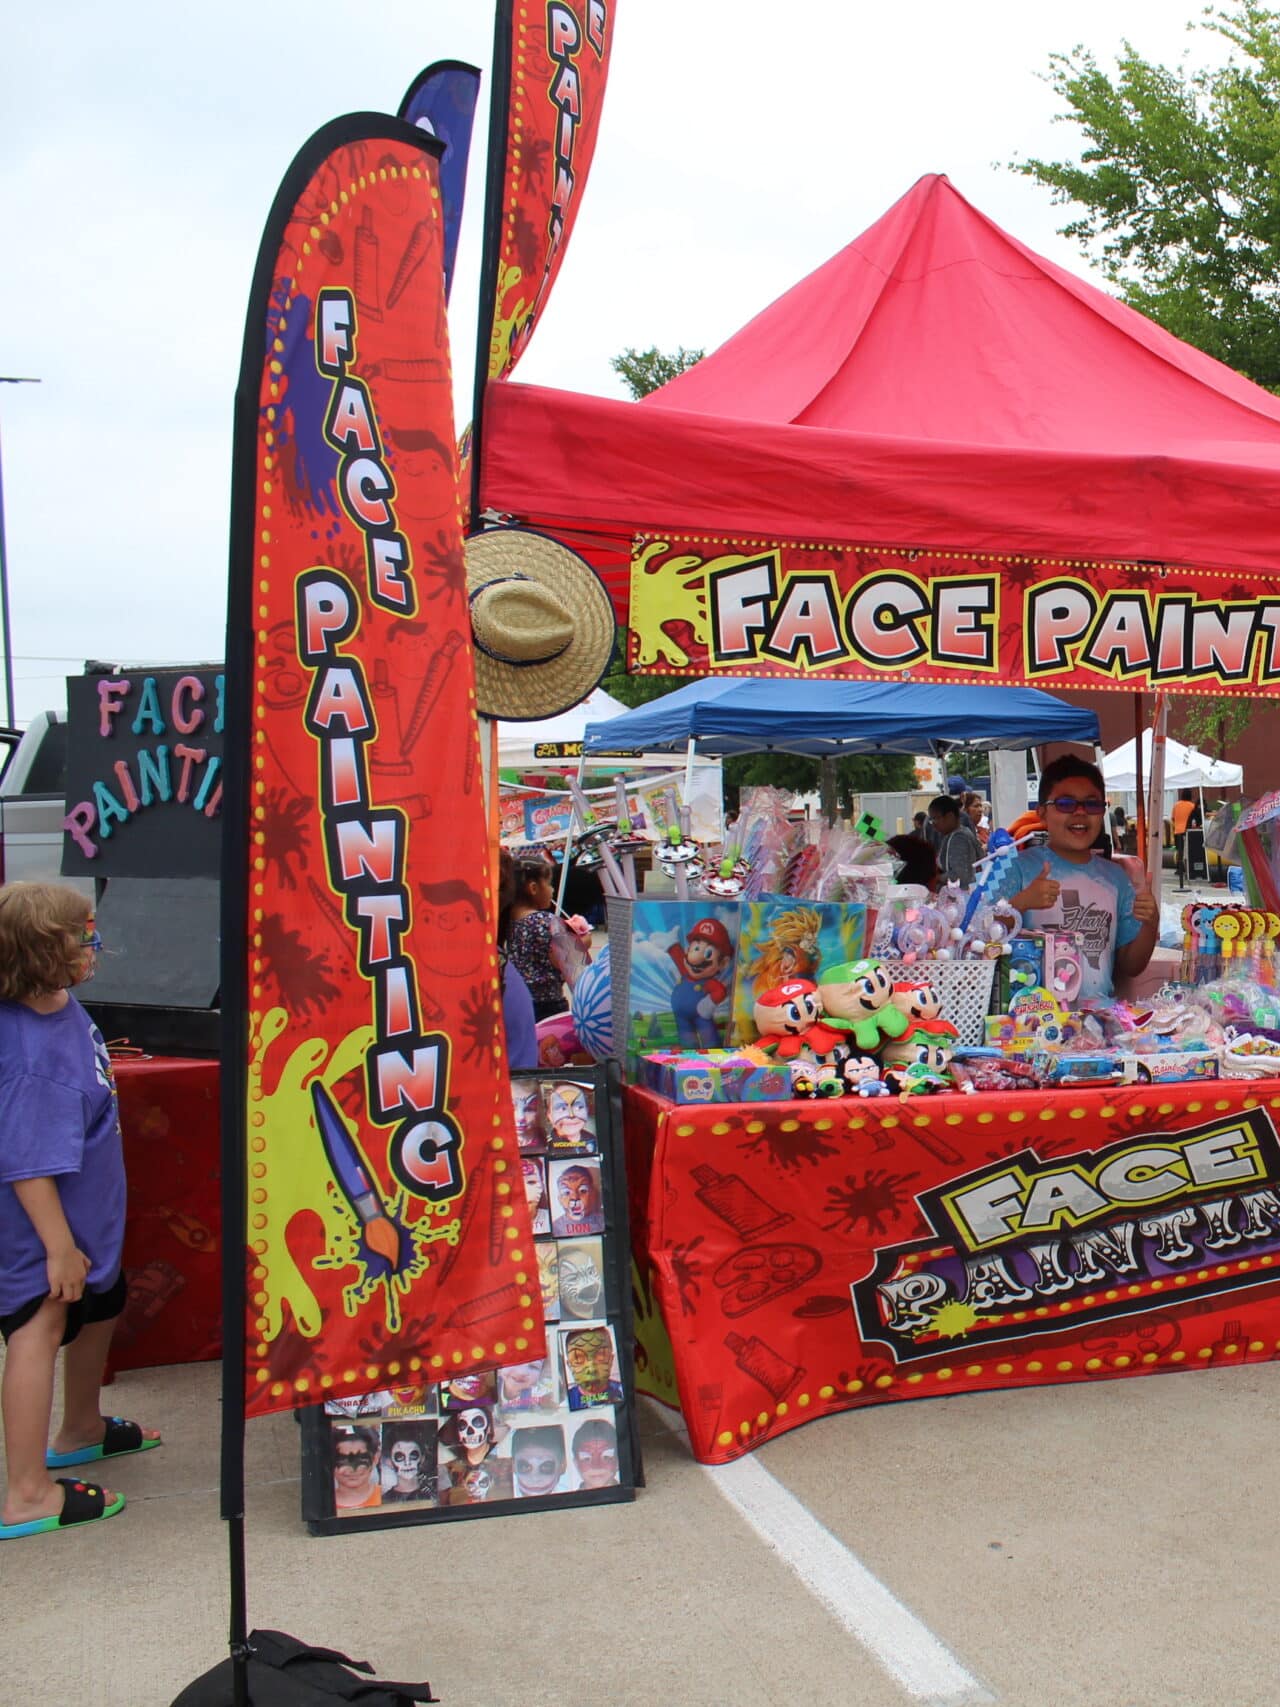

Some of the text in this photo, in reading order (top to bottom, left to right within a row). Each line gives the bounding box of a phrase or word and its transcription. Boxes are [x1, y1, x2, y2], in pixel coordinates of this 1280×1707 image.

[318, 297, 409, 607] FACE
[712, 562, 992, 662] FACE
[61, 743, 224, 859] PAINTI
[302, 580, 456, 1190] PAINTING
[565, 1223, 592, 1235] LION
[955, 1129, 1259, 1245] FACE
[387, 1404, 426, 1417] PIKACHU
